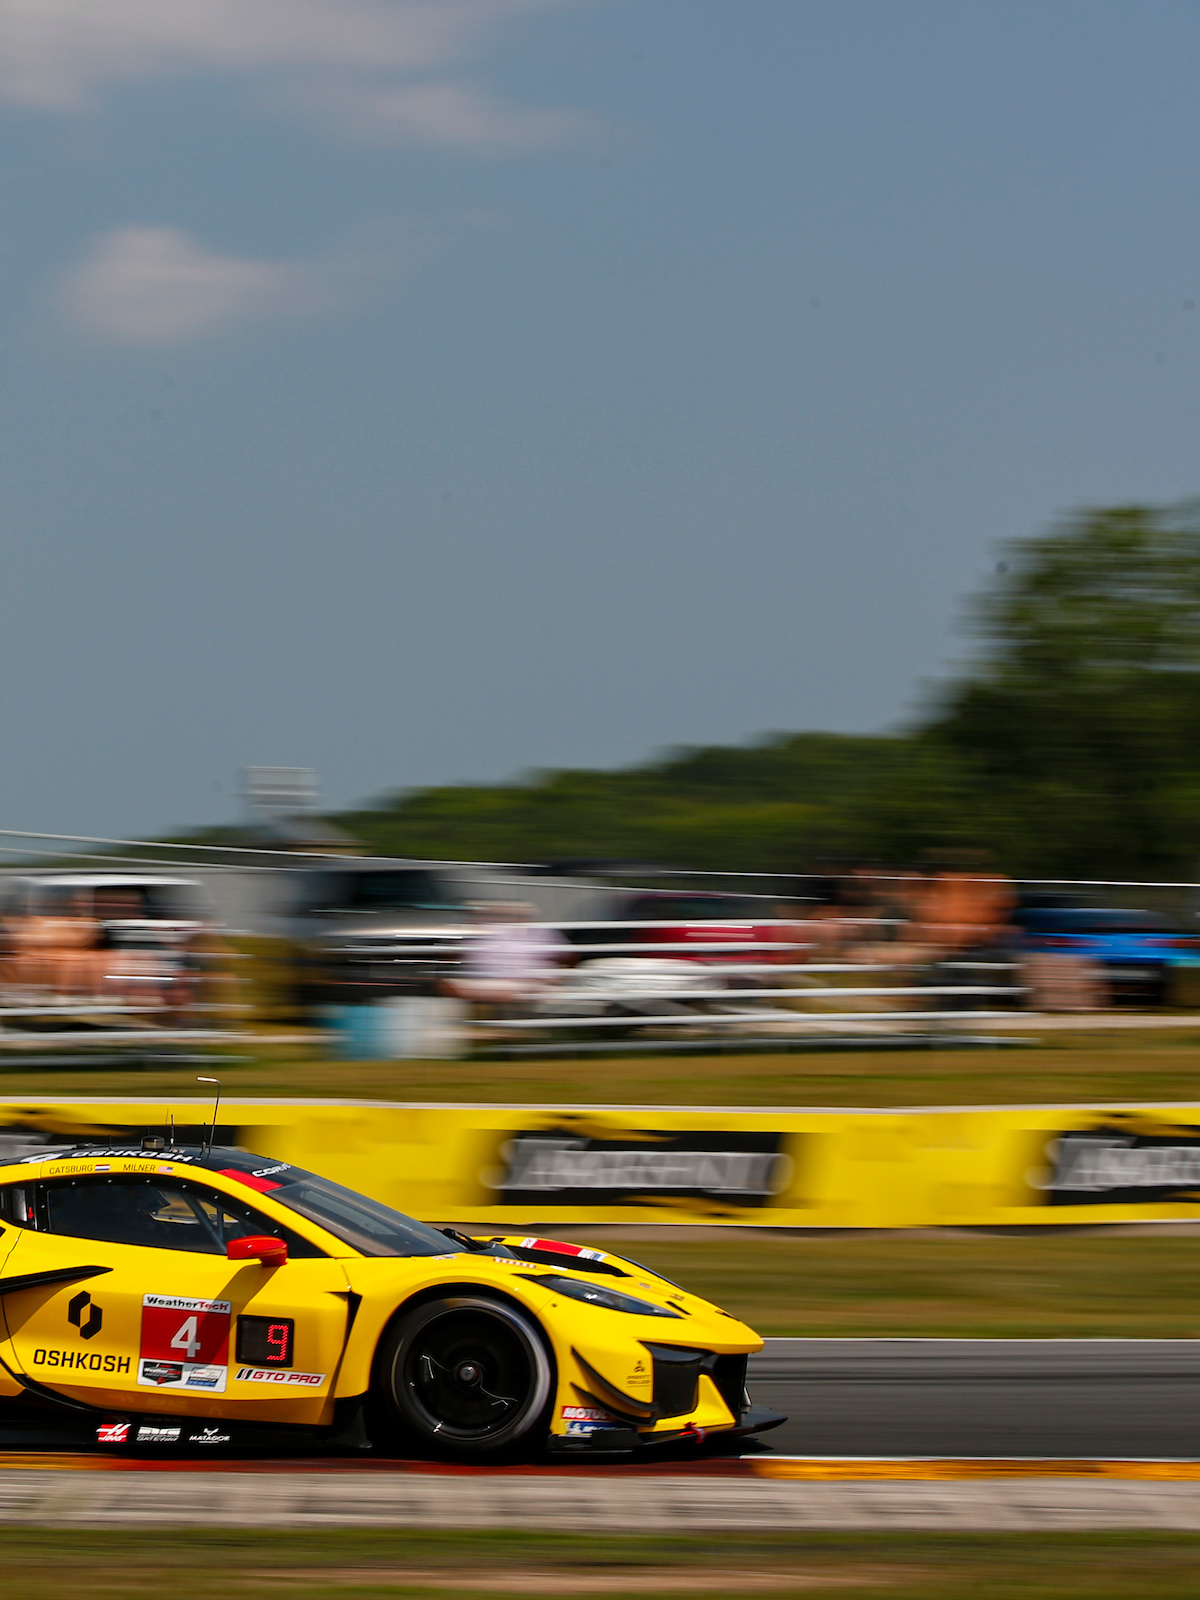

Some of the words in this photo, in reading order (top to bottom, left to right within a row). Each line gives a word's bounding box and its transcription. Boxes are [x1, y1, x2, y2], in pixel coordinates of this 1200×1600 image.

[71, 1150, 193, 1162] OSHKOSH
[49, 1164, 93, 1175] CATSBURG
[122, 1164, 156, 1172] MILNER
[146, 1296, 229, 1311] WeatherTech
[170, 1316, 201, 1357] 4
[267, 1324, 289, 1361] 9
[33, 1349, 131, 1373] OSHKOSH
[287, 1374, 322, 1384] PRO
